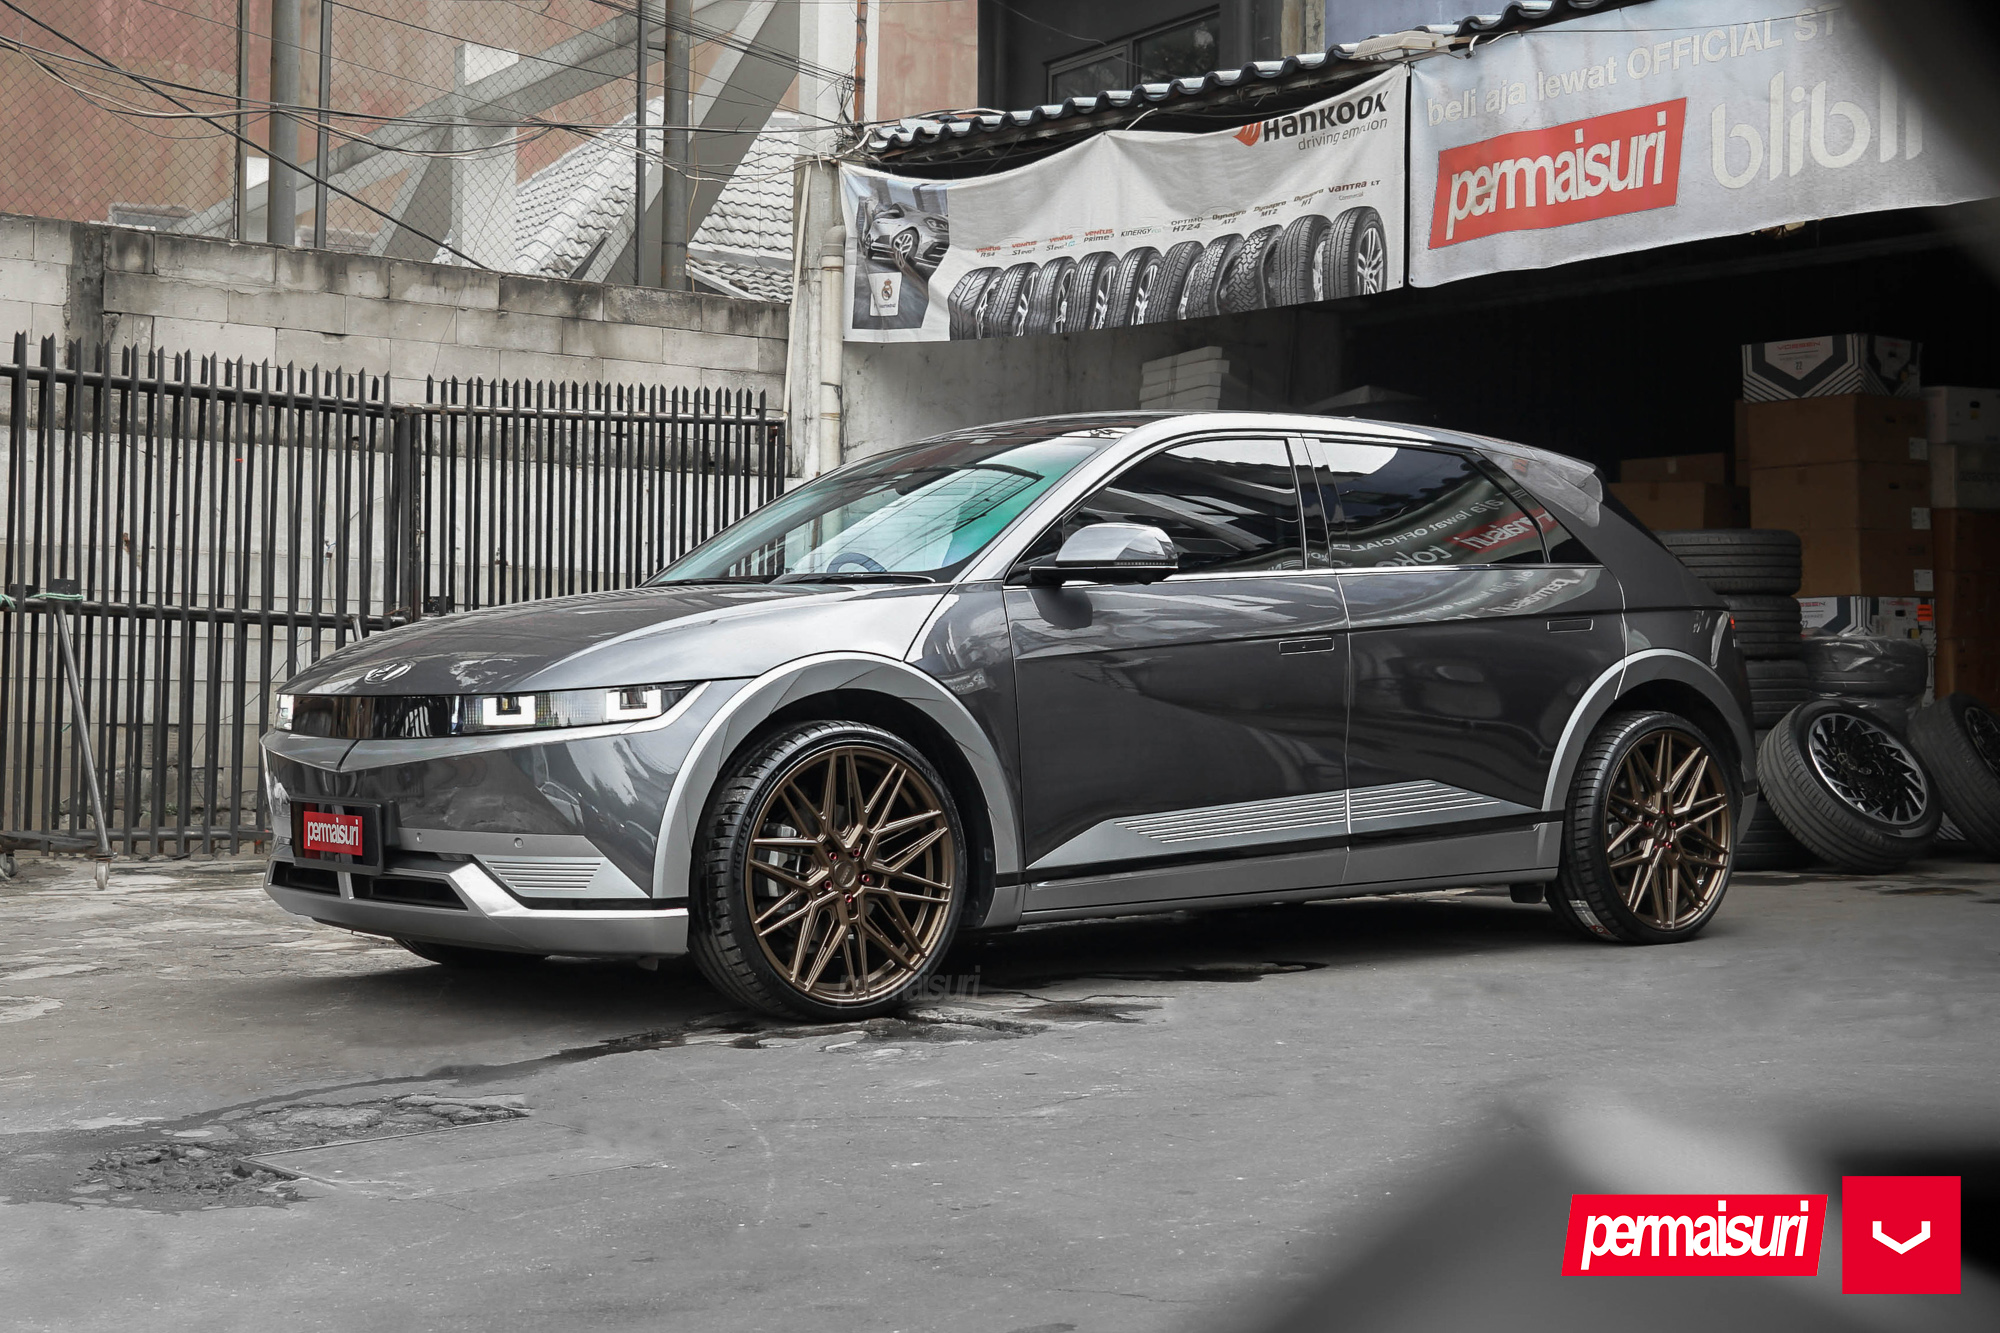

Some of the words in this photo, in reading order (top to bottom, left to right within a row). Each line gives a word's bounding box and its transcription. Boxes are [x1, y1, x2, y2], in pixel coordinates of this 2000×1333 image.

[1427, 93, 1477, 128] beli
[1484, 77, 1528, 116] aja
[1537, 55, 1618, 102] lewat
[1626, 22, 1783, 81] OFFICIAL
[1793, 2, 1846, 43] ST
[1298, 131, 1340, 150] driving
[1445, 110, 1667, 240] permaisuri
[1253, 200, 1287, 212] Dynapro
[1171, 216, 1203, 226] OPTIMO
[1212, 210, 1247, 221] Dynapro
[1172, 222, 1201, 233] H724
[307, 817, 359, 847] permaisuri
